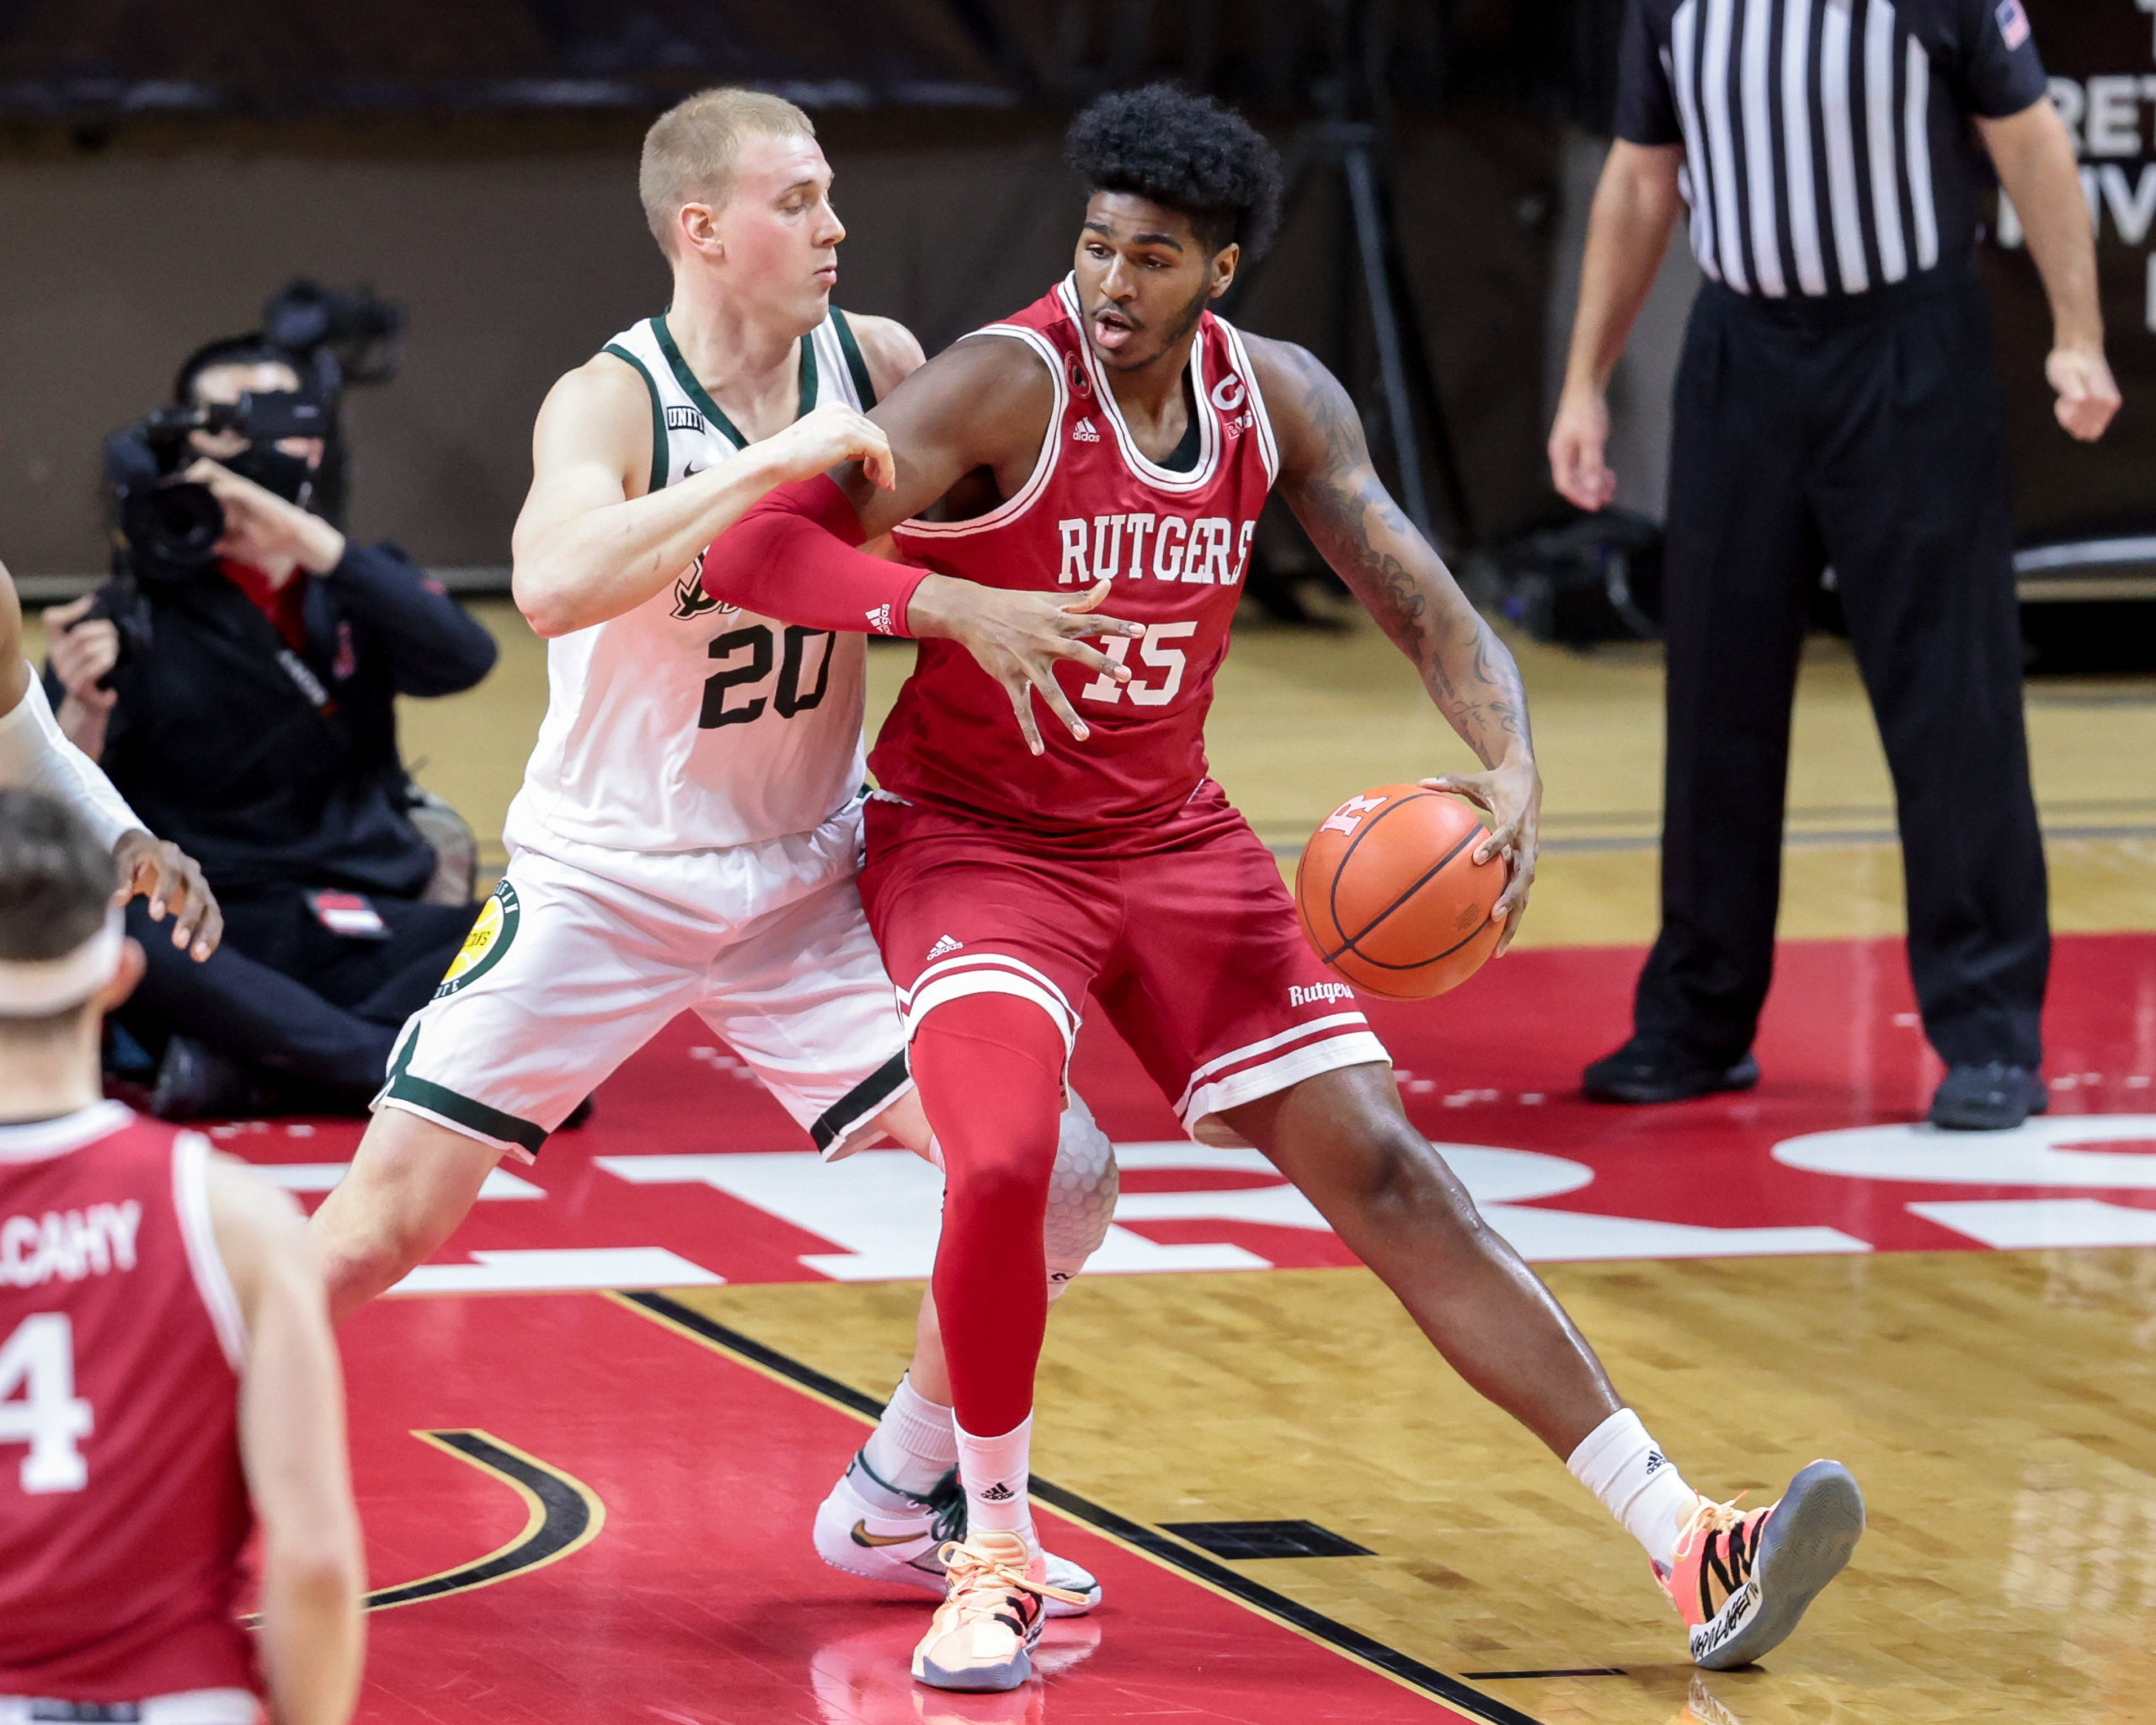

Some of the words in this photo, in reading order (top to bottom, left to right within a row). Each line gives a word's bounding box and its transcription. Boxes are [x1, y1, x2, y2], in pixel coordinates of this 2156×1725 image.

[1213, 373, 1246, 411] C
[1072, 430, 1101, 443] adidas
[1058, 512, 1257, 586] RUTGERS
[698, 624, 836, 729] 20
[1081, 621, 1198, 706] 15
[926, 942, 963, 960] adidas
[0, 1311, 94, 1494] 4
